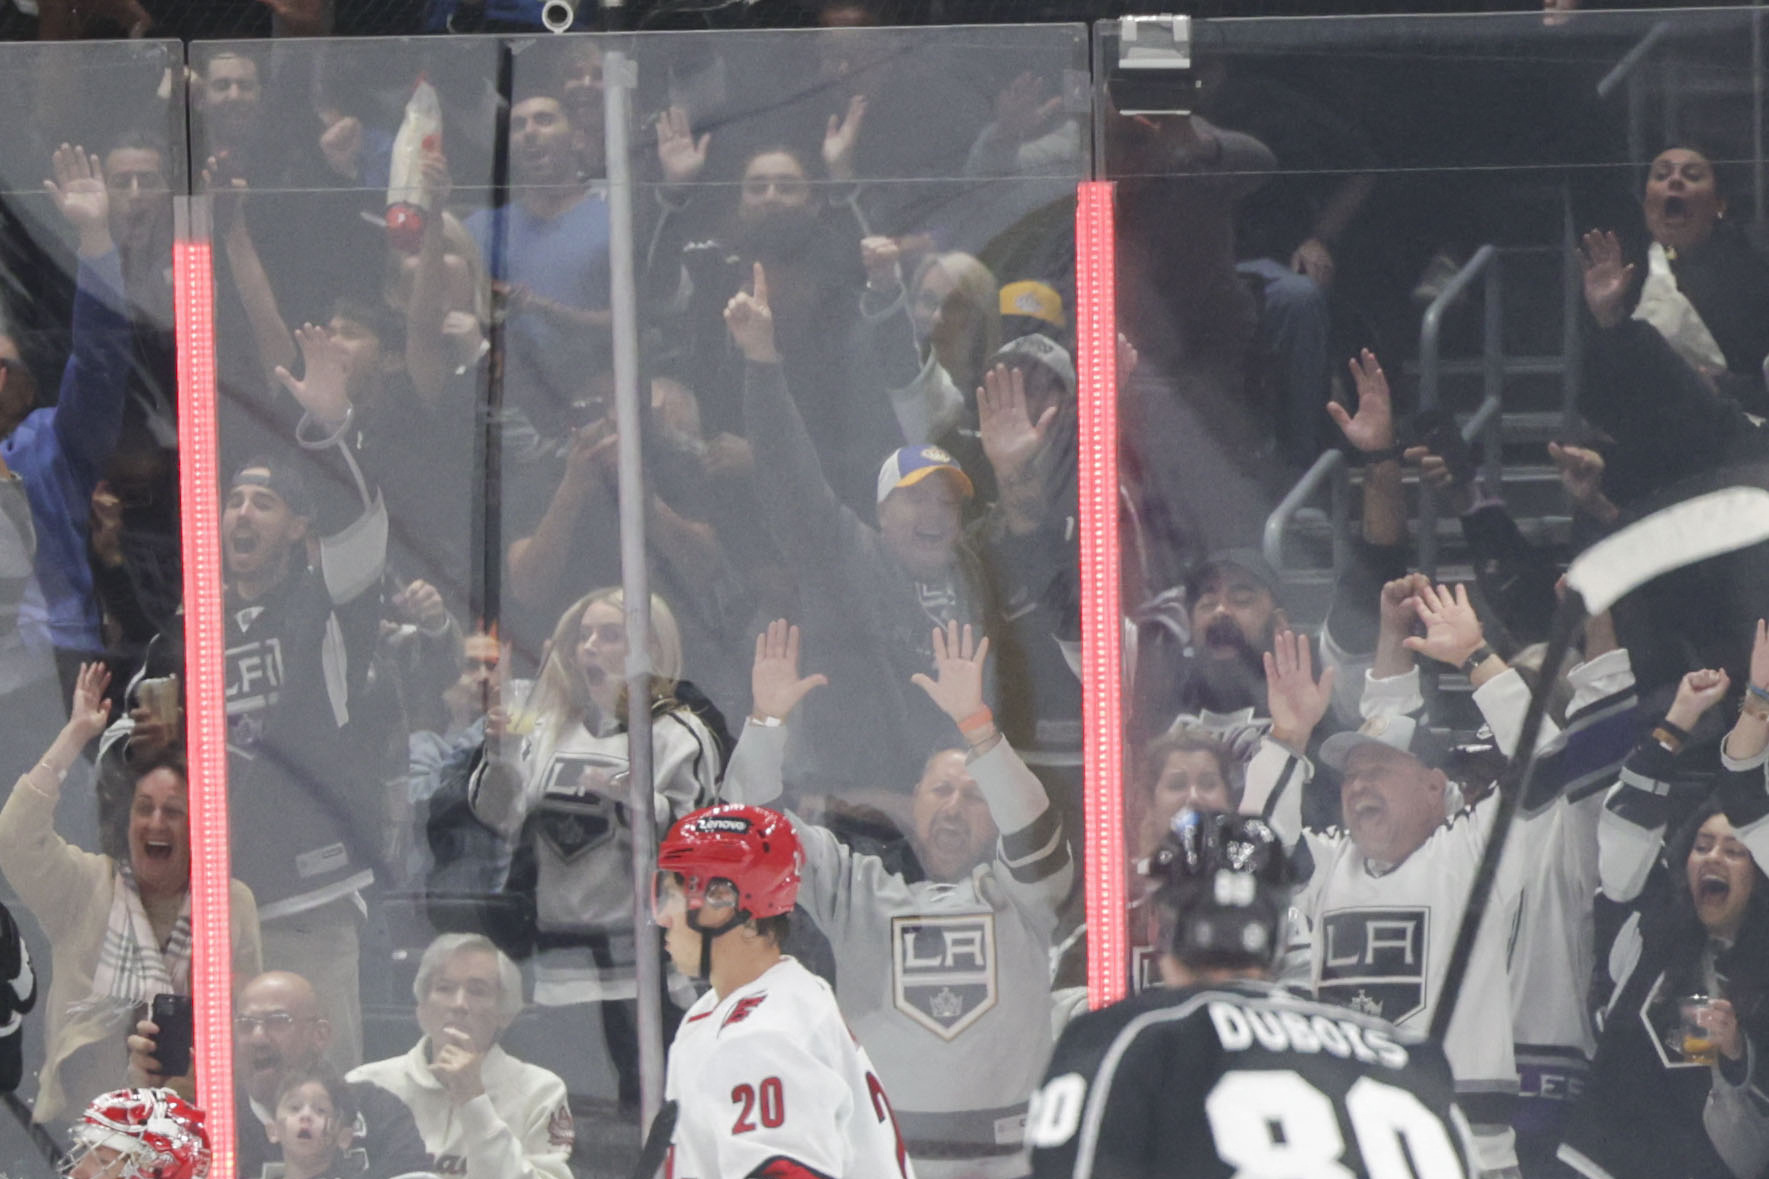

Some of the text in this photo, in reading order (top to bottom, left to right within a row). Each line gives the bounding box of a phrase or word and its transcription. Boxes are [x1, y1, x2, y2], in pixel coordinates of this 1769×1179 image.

[904, 930, 984, 969] LA
[1326, 920, 1417, 967] LA
[1208, 1001, 1409, 1070] DUBOIS
[731, 1076, 785, 1136] 20
